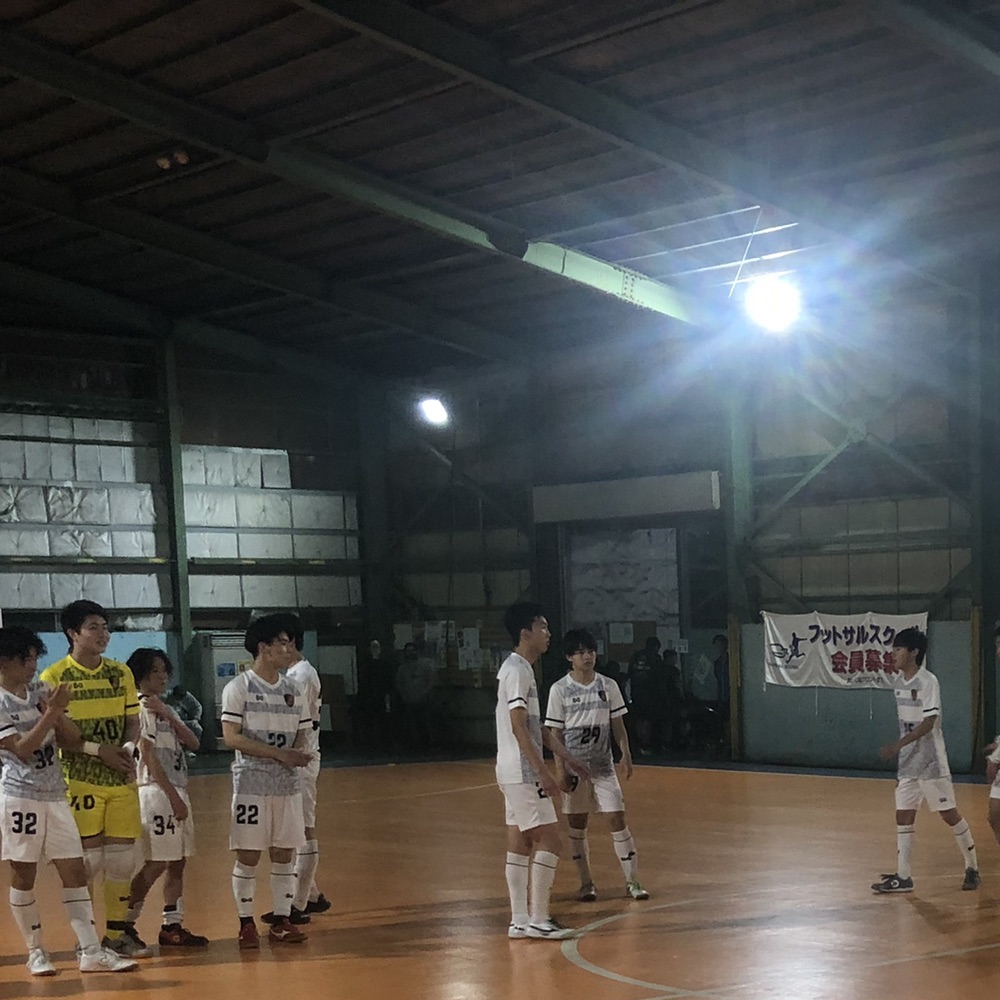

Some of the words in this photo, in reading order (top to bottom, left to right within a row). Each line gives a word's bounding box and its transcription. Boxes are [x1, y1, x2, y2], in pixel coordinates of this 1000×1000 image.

[93, 719, 118, 741] 40
[581, 727, 601, 744] 29
[12, 811, 38, 835] 32
[236, 804, 259, 825] 22
[153, 815, 176, 836] 34
